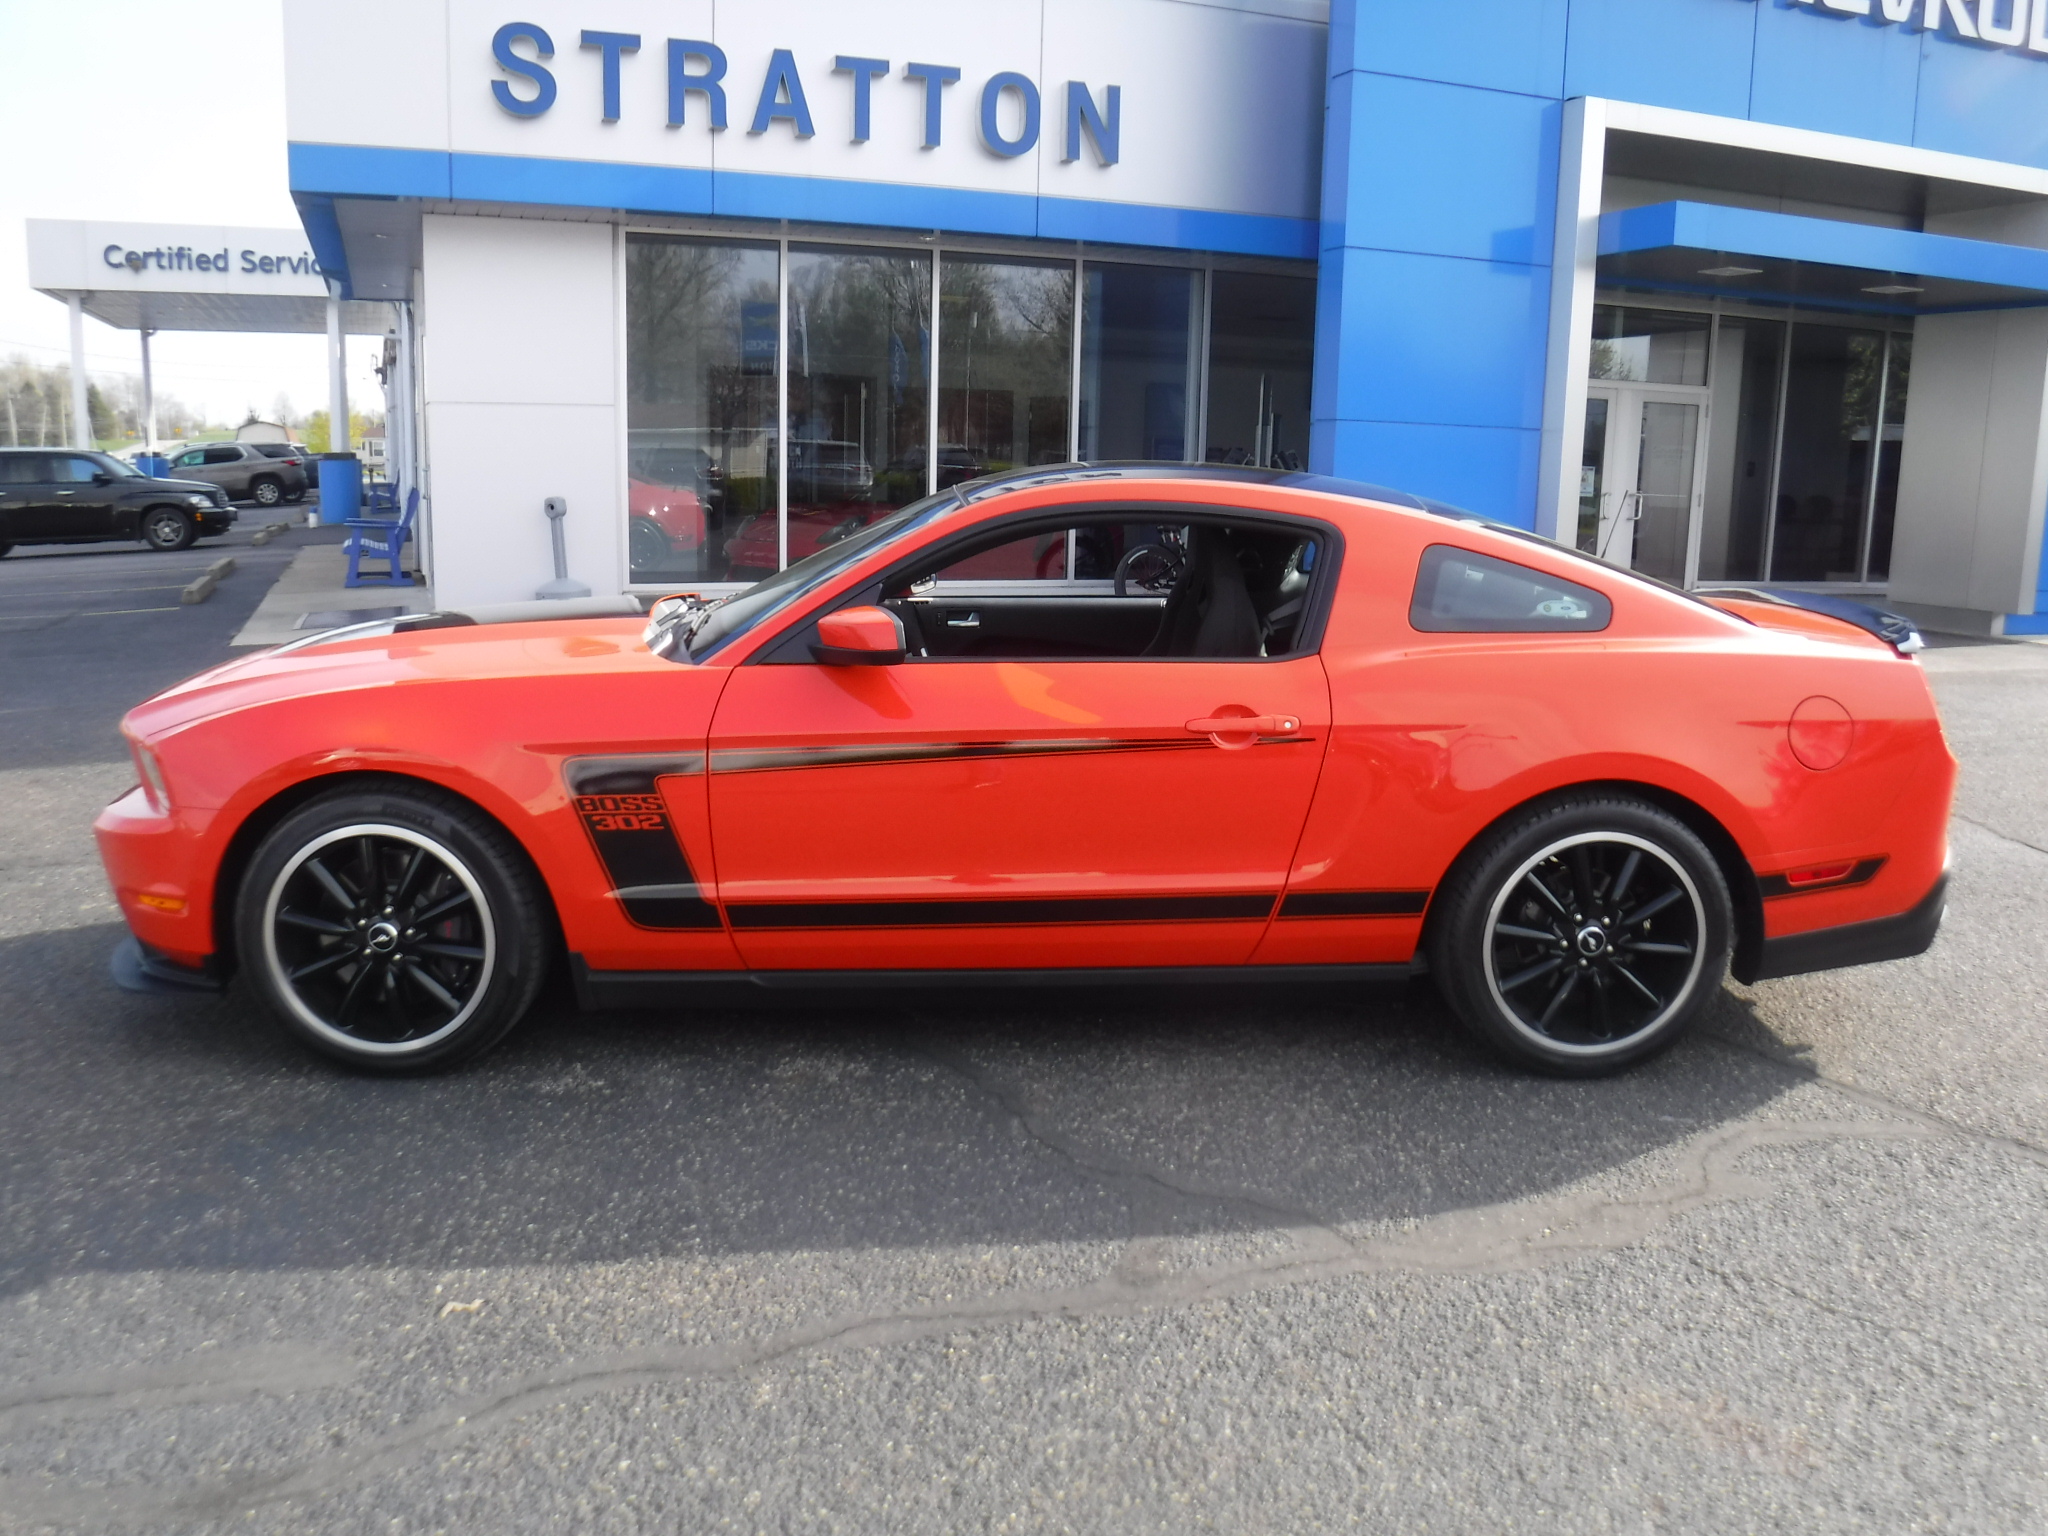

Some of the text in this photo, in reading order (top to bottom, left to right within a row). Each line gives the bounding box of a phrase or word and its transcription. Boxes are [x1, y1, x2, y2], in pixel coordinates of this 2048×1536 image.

[490, 22, 1121, 166] STRATTON
[103, 243, 322, 275] Certified Servic
[576, 796, 664, 811] BOSS
[591, 814, 665, 831] 302
